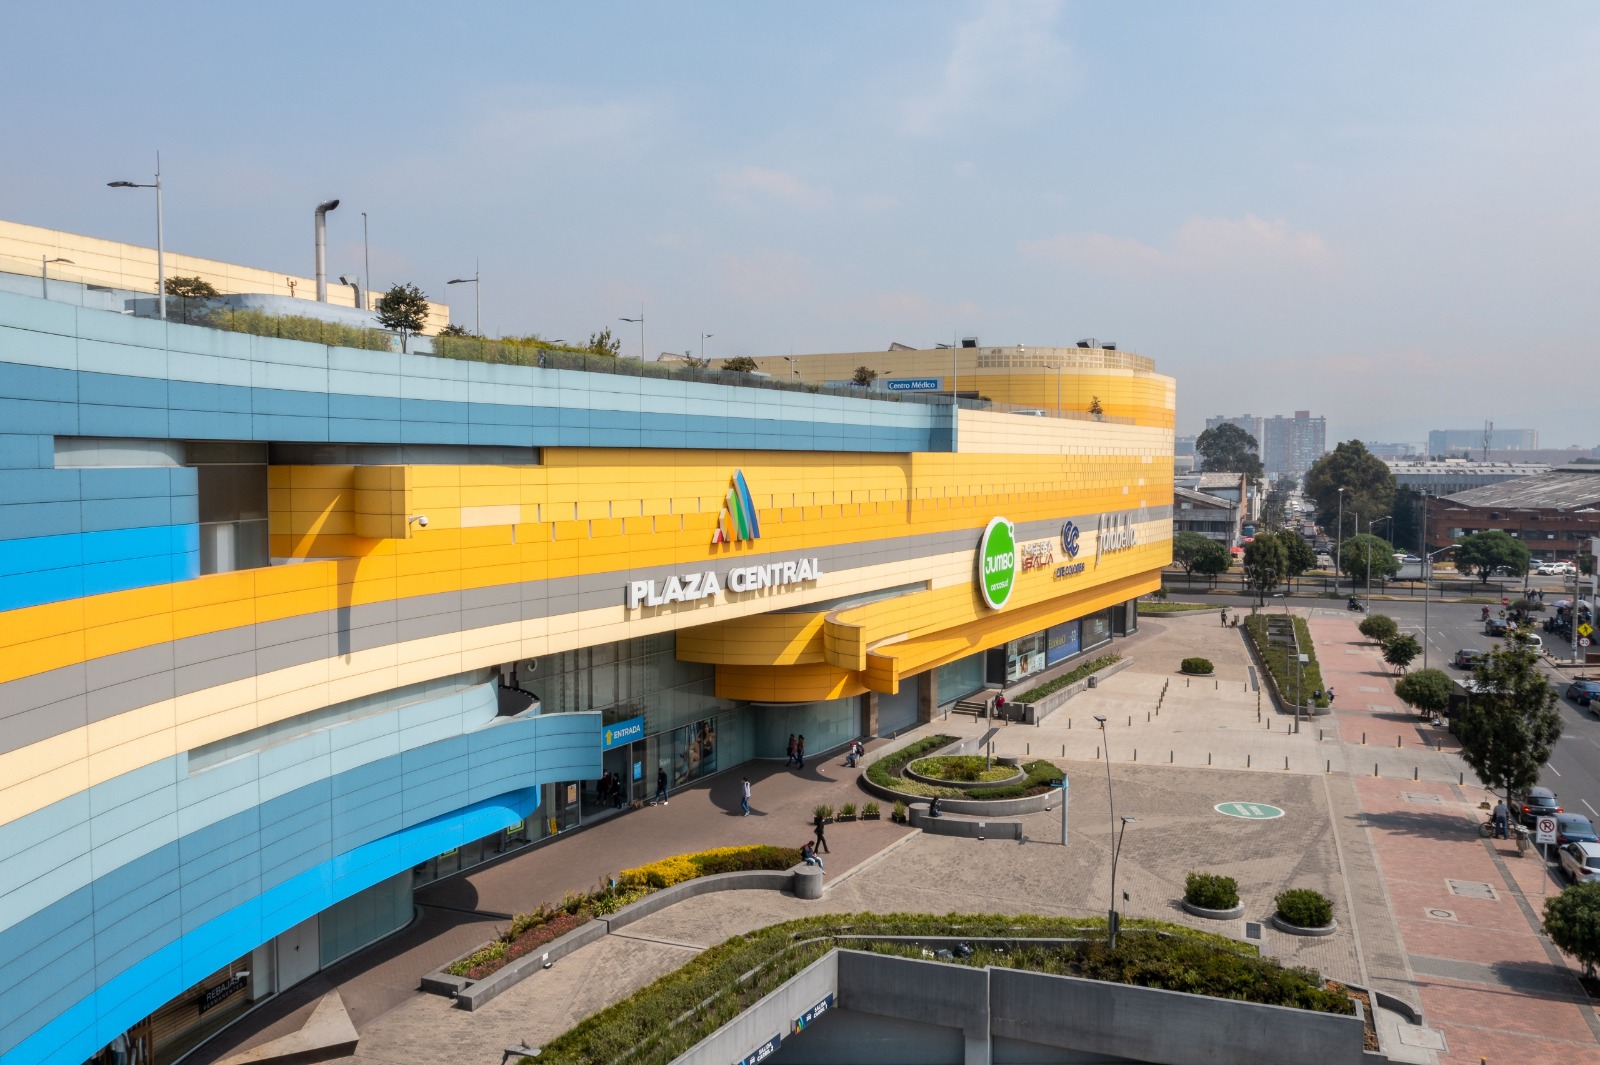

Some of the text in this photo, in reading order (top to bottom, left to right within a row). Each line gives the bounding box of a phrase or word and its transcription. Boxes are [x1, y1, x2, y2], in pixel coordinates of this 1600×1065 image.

[986, 552, 1013, 574] JUMBO
[1023, 553, 1053, 569] SALA
[627, 558, 823, 609] PLAZA CENTRAL
[991, 578, 1008, 591] cencosud
[614, 725, 640, 739] ENTRADA
[206, 977, 240, 1002] REBAJAS
[814, 1000, 827, 1012] SALIDA
[758, 1041, 772, 1055] SALIDA
